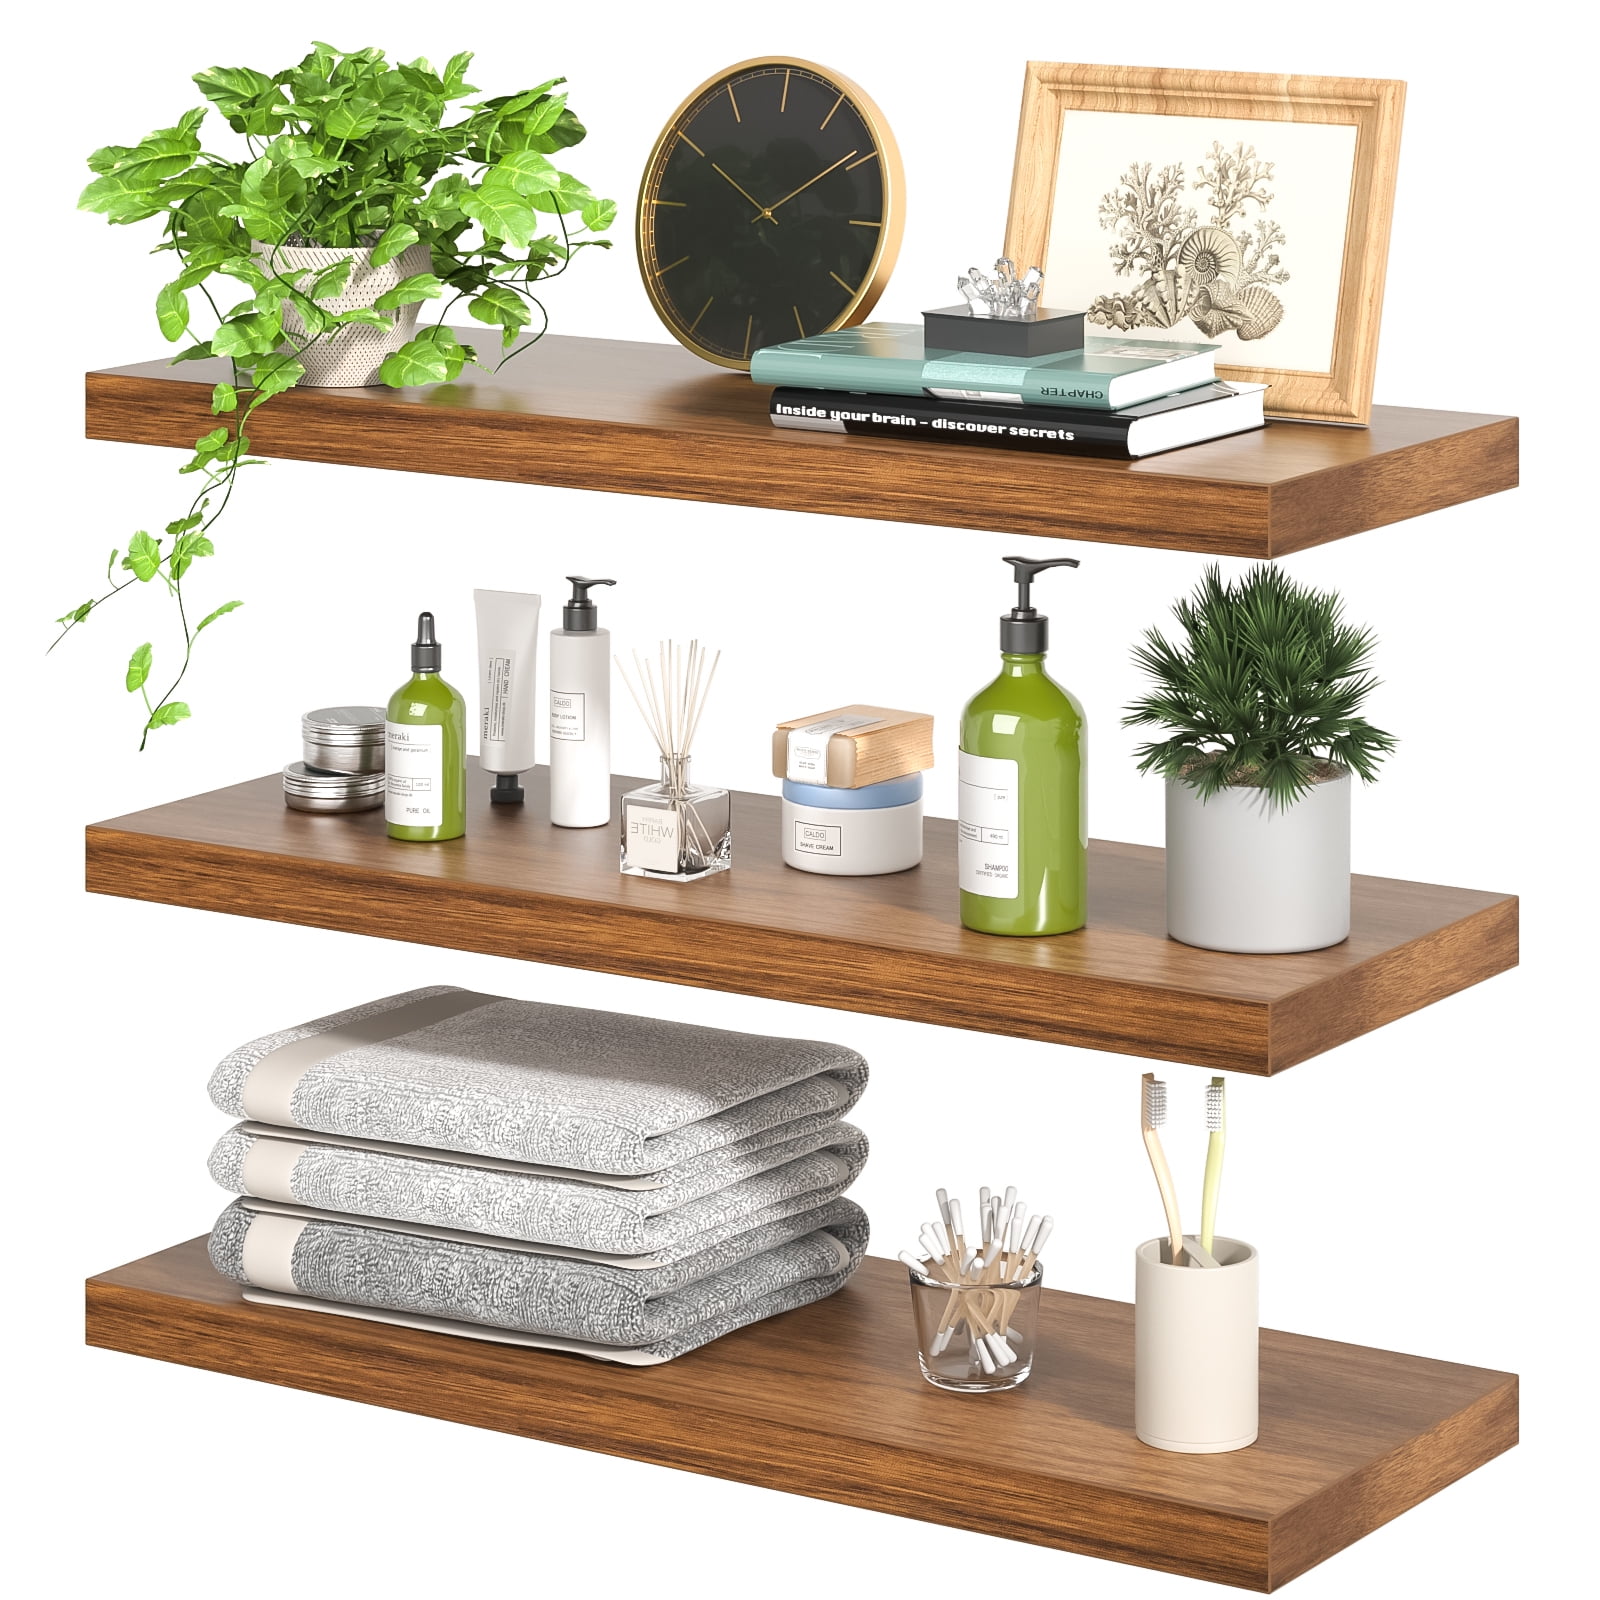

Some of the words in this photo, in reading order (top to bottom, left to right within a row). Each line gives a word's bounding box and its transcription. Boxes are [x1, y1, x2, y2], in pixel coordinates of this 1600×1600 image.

[1040, 386, 1104, 400] CHAPTER
[776, 403, 827, 418] Inside
[830, 410, 871, 421] your
[871, 412, 917, 426] brain
[931, 418, 1007, 434] discover
[1009, 425, 1075, 441] secrets
[502, 680, 510, 695] HAND
[805, 830, 825, 839] CALDO
[984, 863, 1009, 872] SHAMPOO
